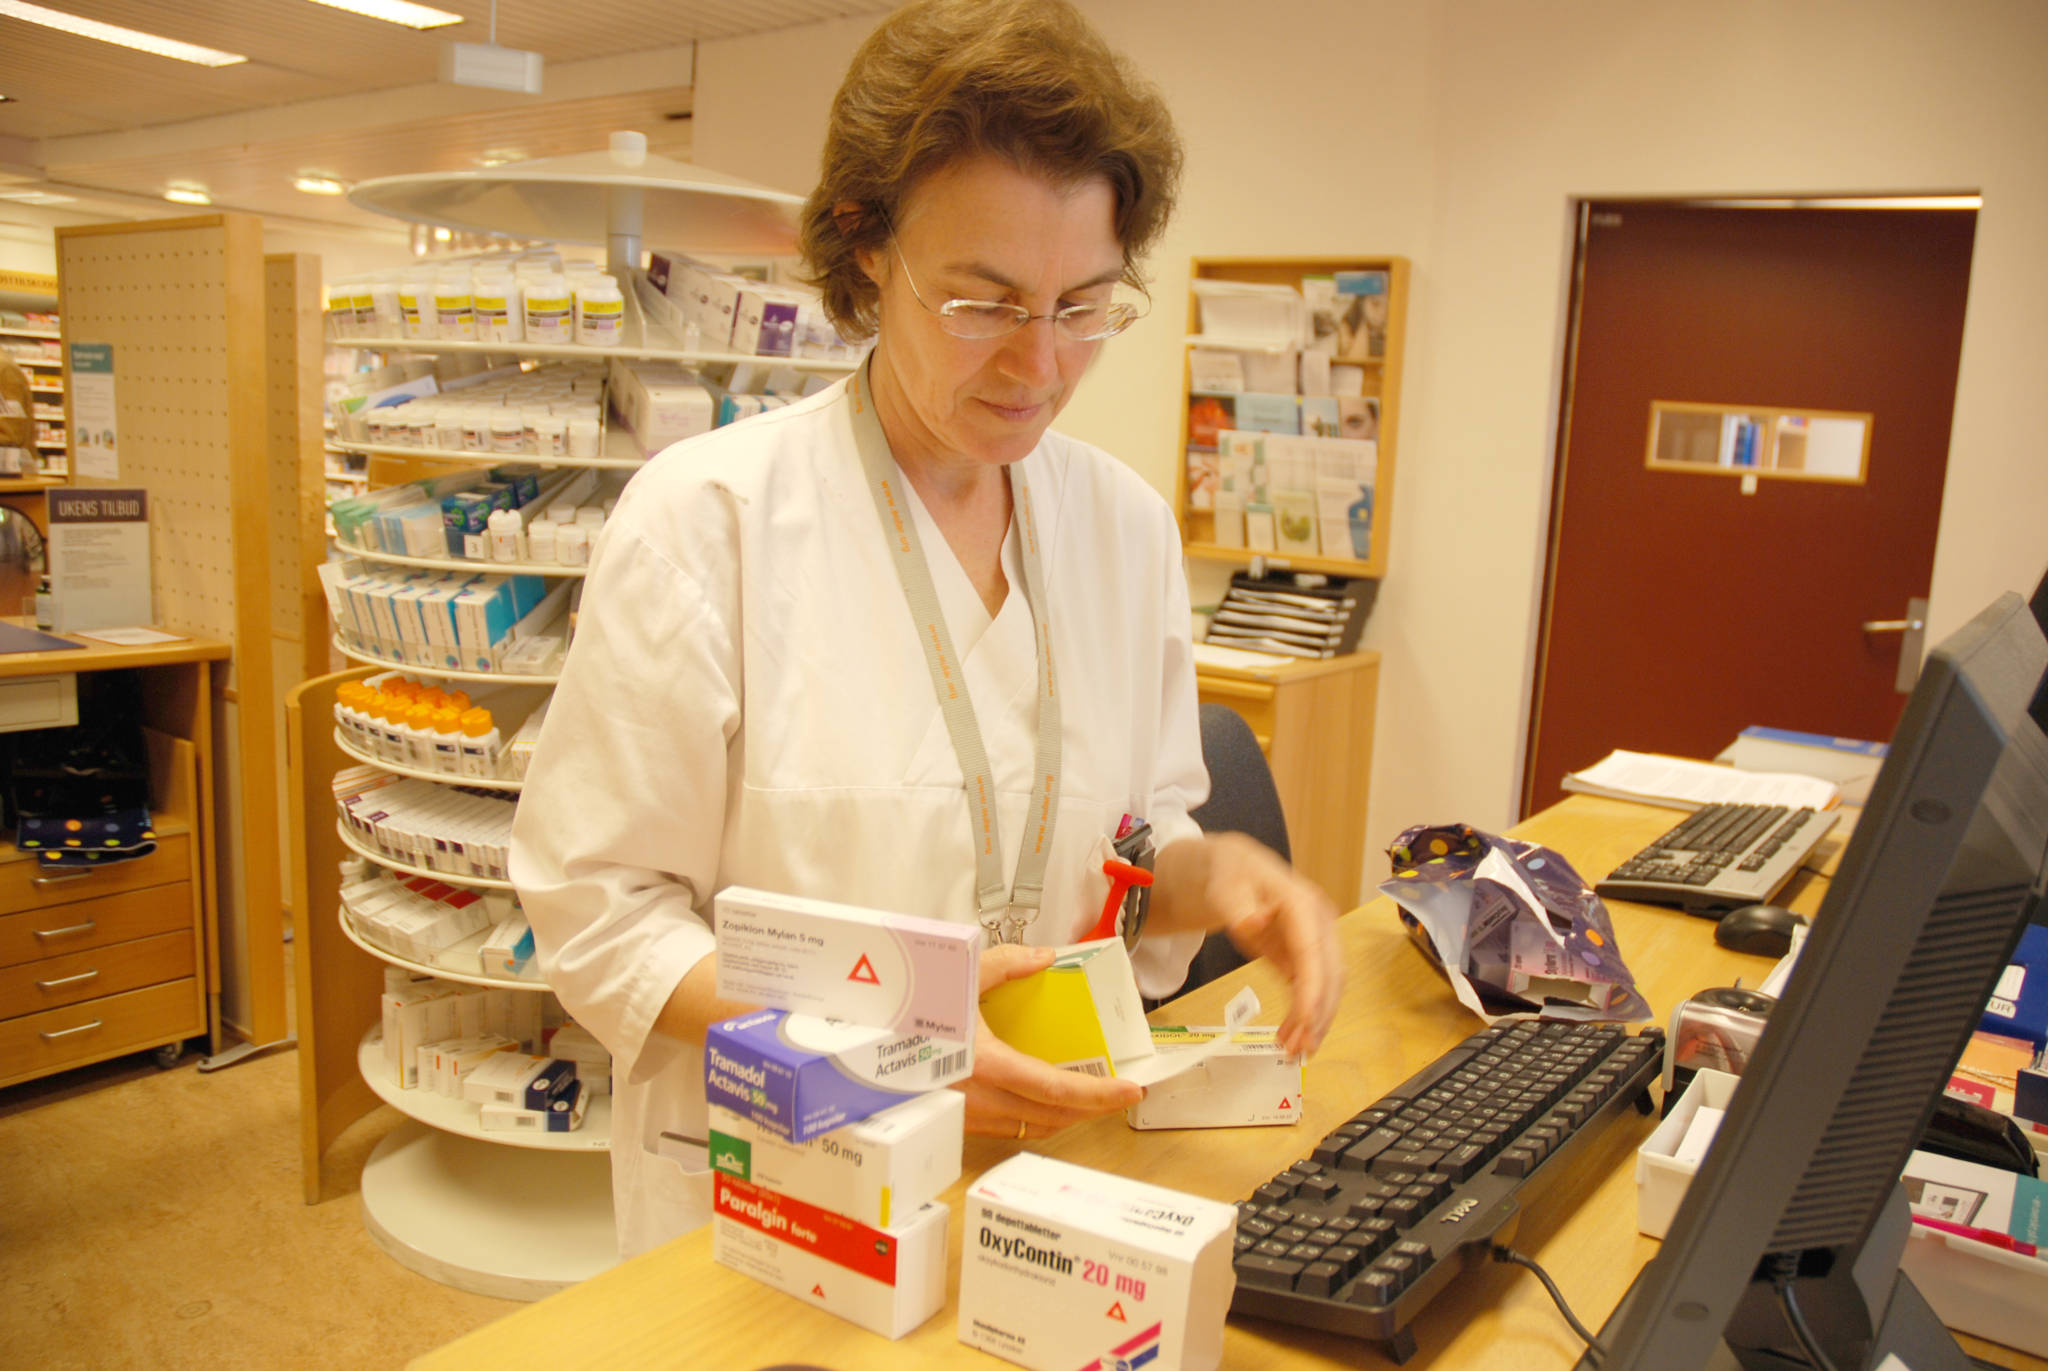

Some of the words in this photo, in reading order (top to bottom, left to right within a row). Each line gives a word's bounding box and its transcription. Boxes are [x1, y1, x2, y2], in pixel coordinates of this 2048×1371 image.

[58, 499, 98, 517] UKENS
[102, 499, 140, 517] TILBUD
[722, 919, 766, 938] Zopiklon
[767, 926, 797, 943] Mylan
[799, 930, 806, 940] 5
[808, 934, 825, 948] mg
[926, 1020, 957, 1034] Mylan
[877, 1034, 931, 1059] Tramado
[709, 1047, 766, 1089] Tramadol
[875, 1053, 917, 1079] Actavis
[708, 1068, 751, 1102] Actavis
[822, 1137, 840, 1157] 50
[842, 1147, 864, 1168] mg
[720, 1186, 788, 1231] Paralgin
[791, 1221, 818, 1244] forte
[1440, 1198, 1480, 1223] DELL
[1082, 1259, 1110, 1288] 20
[1115, 1273, 1147, 1302] mg
